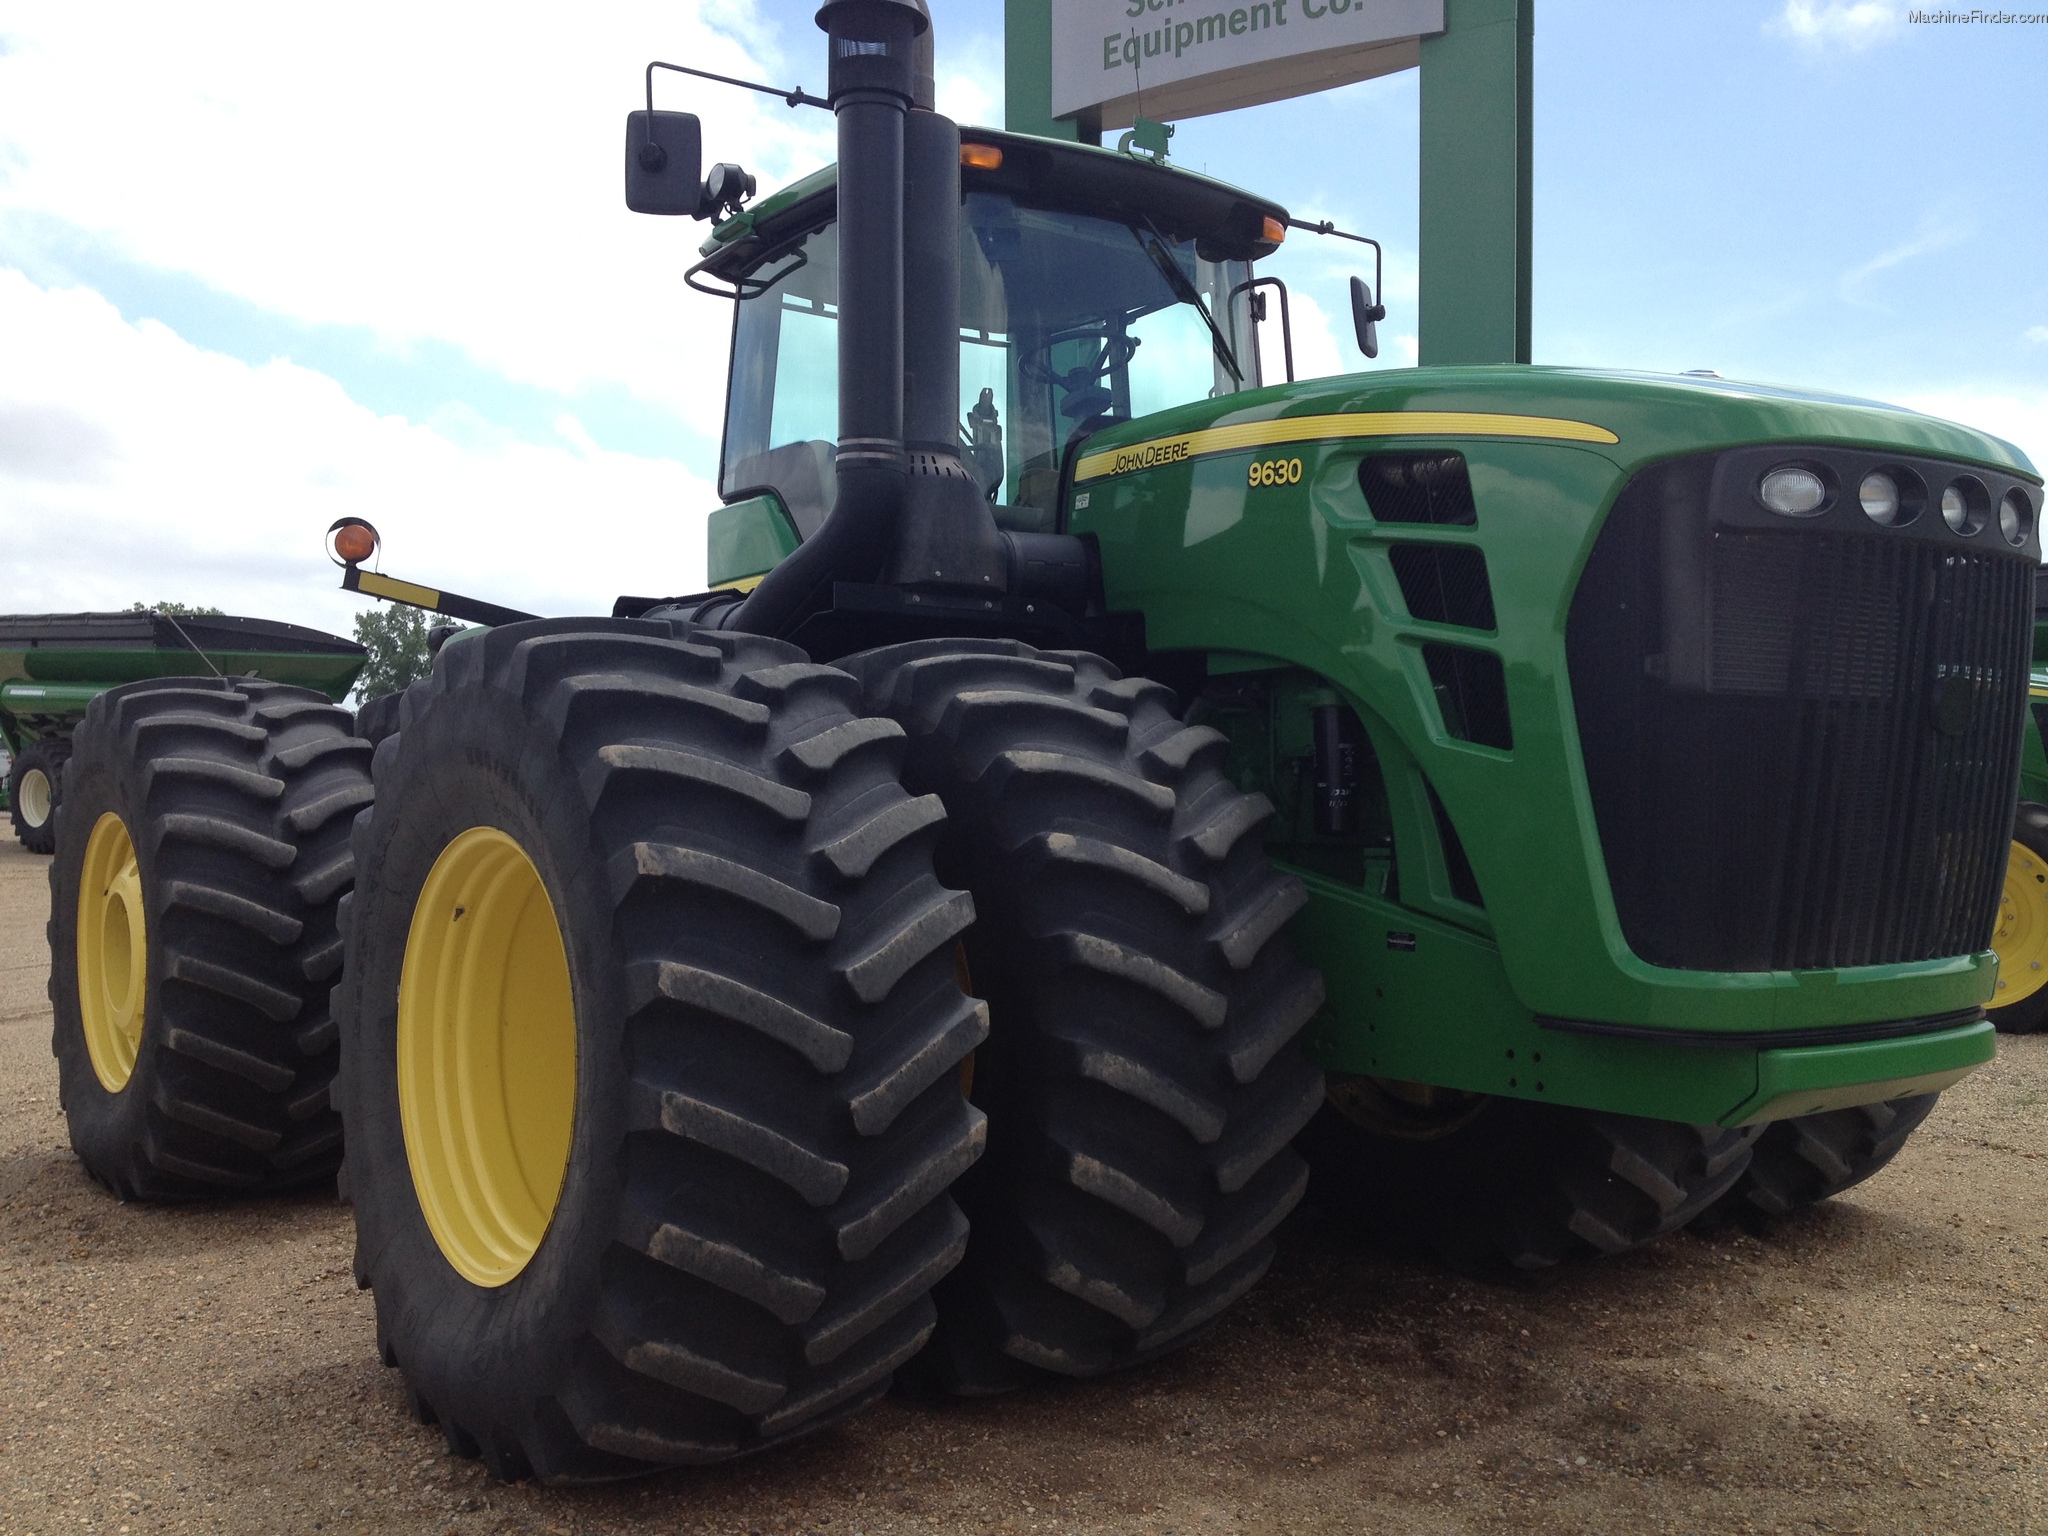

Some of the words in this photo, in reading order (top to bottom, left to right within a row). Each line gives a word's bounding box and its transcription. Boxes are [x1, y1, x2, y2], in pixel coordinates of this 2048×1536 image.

[1104, 0, 1288, 70] Equipment
[1111, 452, 1144, 473] JOHN
[1145, 441, 1190, 465] DEERE
[1248, 457, 1303, 488] 9630
